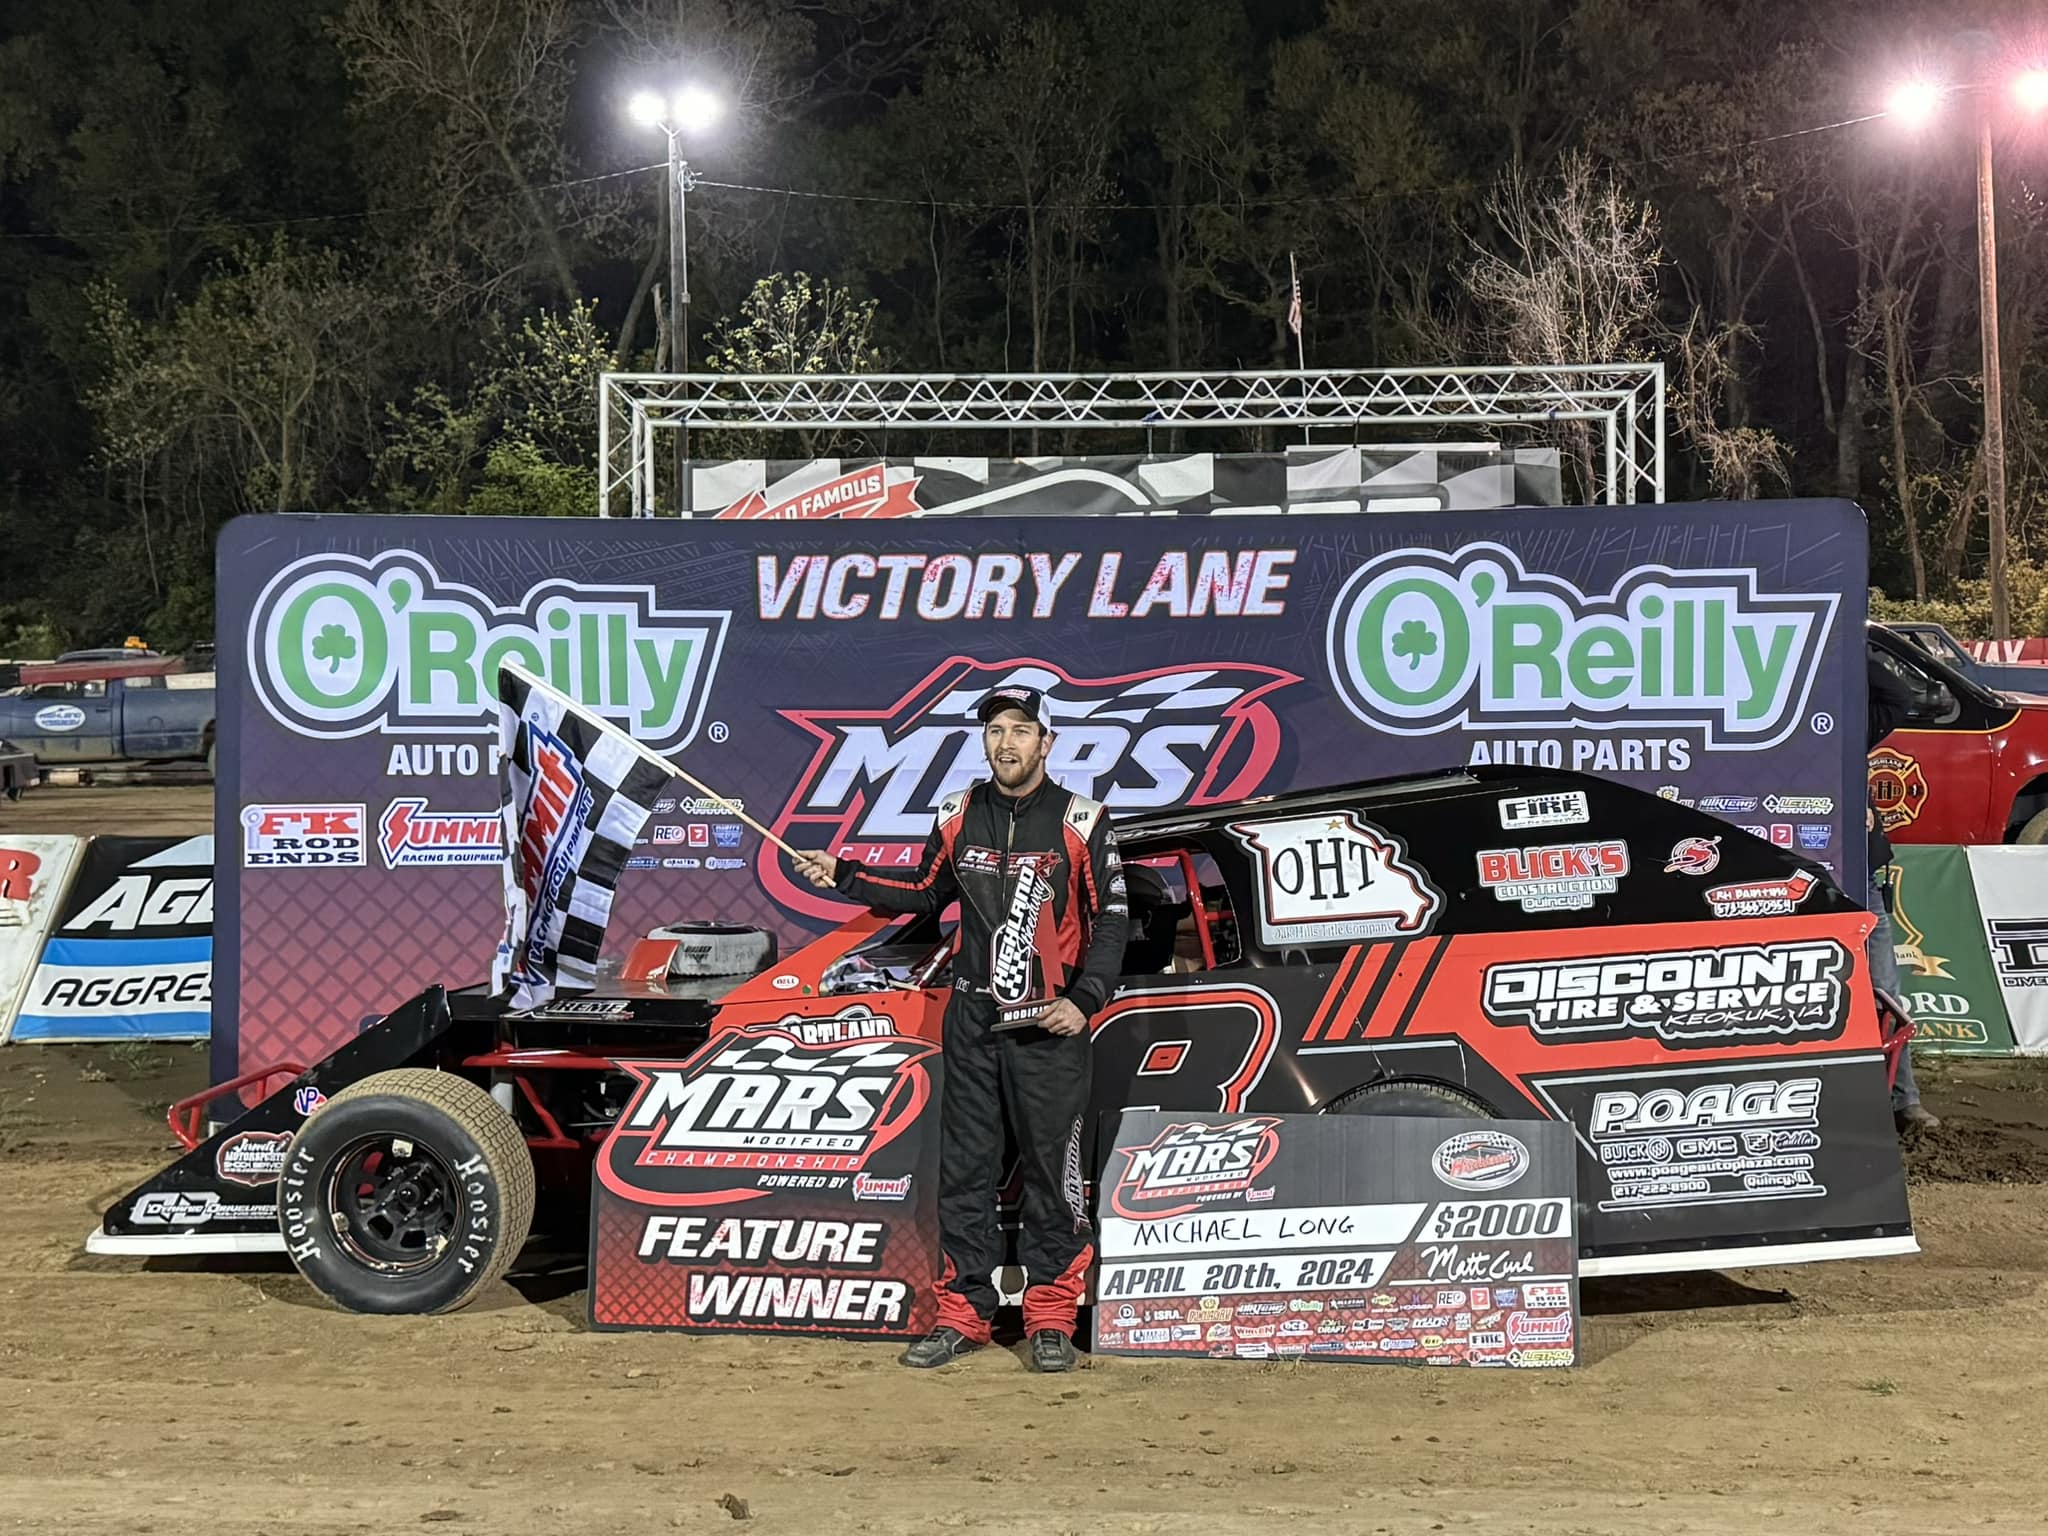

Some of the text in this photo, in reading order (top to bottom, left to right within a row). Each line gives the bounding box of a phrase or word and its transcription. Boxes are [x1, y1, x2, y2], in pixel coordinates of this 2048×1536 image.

[801, 473, 882, 517] FAMOUS
[757, 549, 1297, 620] VICTORY LANE
[1357, 571, 1799, 719] O'Reilly
[386, 744, 479, 776] AUTO
[1469, 738, 1690, 771] AUTO PARTS
[259, 812, 358, 835] FK
[1506, 799, 1580, 820] FIRE
[247, 852, 359, 865] ENDS
[273, 838, 359, 850] ROD
[402, 854, 444, 862] RACING
[545, 786, 595, 900] EQUIPMENT
[1272, 837, 1379, 901] OHT
[1480, 845, 1627, 884] BLICK'S
[1497, 878, 1614, 897] CONSTRUCTION
[993, 866, 1036, 988] HIGHLAND
[1273, 923, 1395, 940] Oak Hills Title Company
[1492, 949, 1832, 1004] DISCOUNT
[1004, 1006, 1048, 1022] MODIFI
[1536, 982, 1830, 1023] TIRE & SERVICE
[1917, 1023, 1977, 1039] ANK
[297, 1088, 318, 1114] VP
[629, 1071, 894, 1146] MARS
[1594, 1080, 1820, 1134] POAGE
[743, 1135, 854, 1147] MODIFIED
[1604, 1143, 1648, 1162] BUICK
[1681, 1139, 1736, 1154] GMC
[646, 1152, 861, 1170] CHAMPIONSHIP
[1127, 1138, 1259, 1186] MARS
[757, 1173, 828, 1188] POWERED
[829, 1176, 848, 1189] BY
[1195, 1191, 1231, 1202] POWERED
[453, 1151, 494, 1275] Hoosier
[1435, 1202, 1564, 1239] $2000
[638, 1216, 883, 1264] FEATURE
[1134, 1215, 1355, 1246] MICHAEL LONG
[1104, 1258, 1374, 1296] APRIL 20th, 2024
[1421, 1244, 1490, 1281] Matt
[689, 1274, 908, 1322] WINNER
